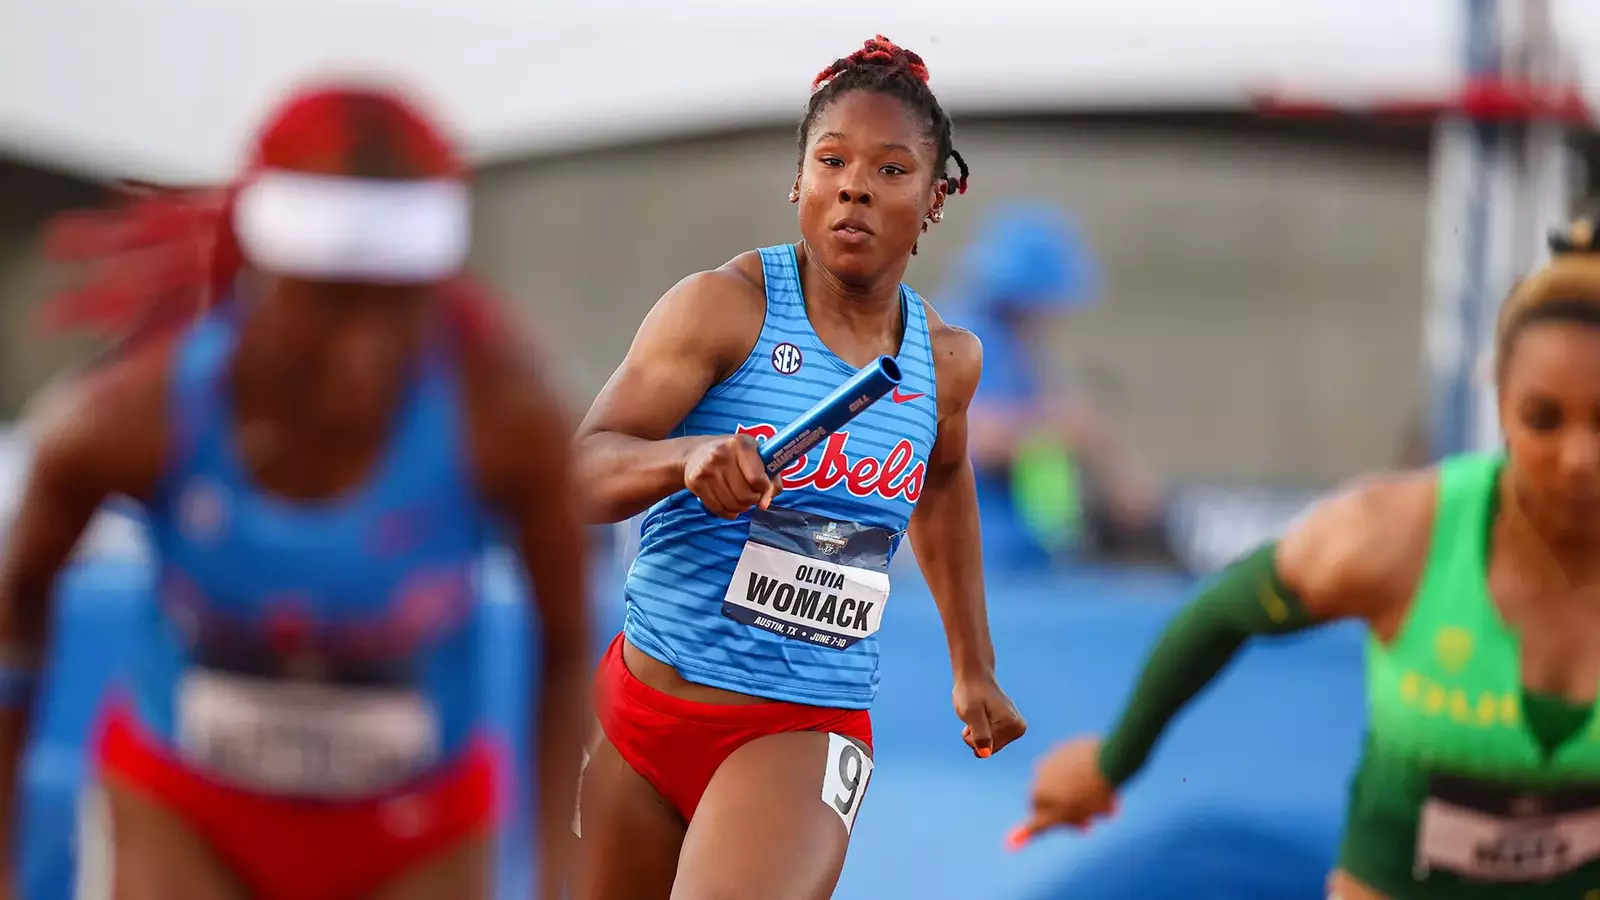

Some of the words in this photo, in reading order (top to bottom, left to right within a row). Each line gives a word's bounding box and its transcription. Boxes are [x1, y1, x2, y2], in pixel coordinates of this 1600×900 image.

[773, 344, 801, 373] SEC
[795, 564, 845, 590] OLIVIA
[745, 572, 874, 631] WOMACK
[754, 616, 785, 634] AUSTIN,
[786, 626, 799, 636] TX
[810, 632, 832, 645] JUNE
[830, 636, 847, 648] 7-10
[833, 744, 862, 815] 9
